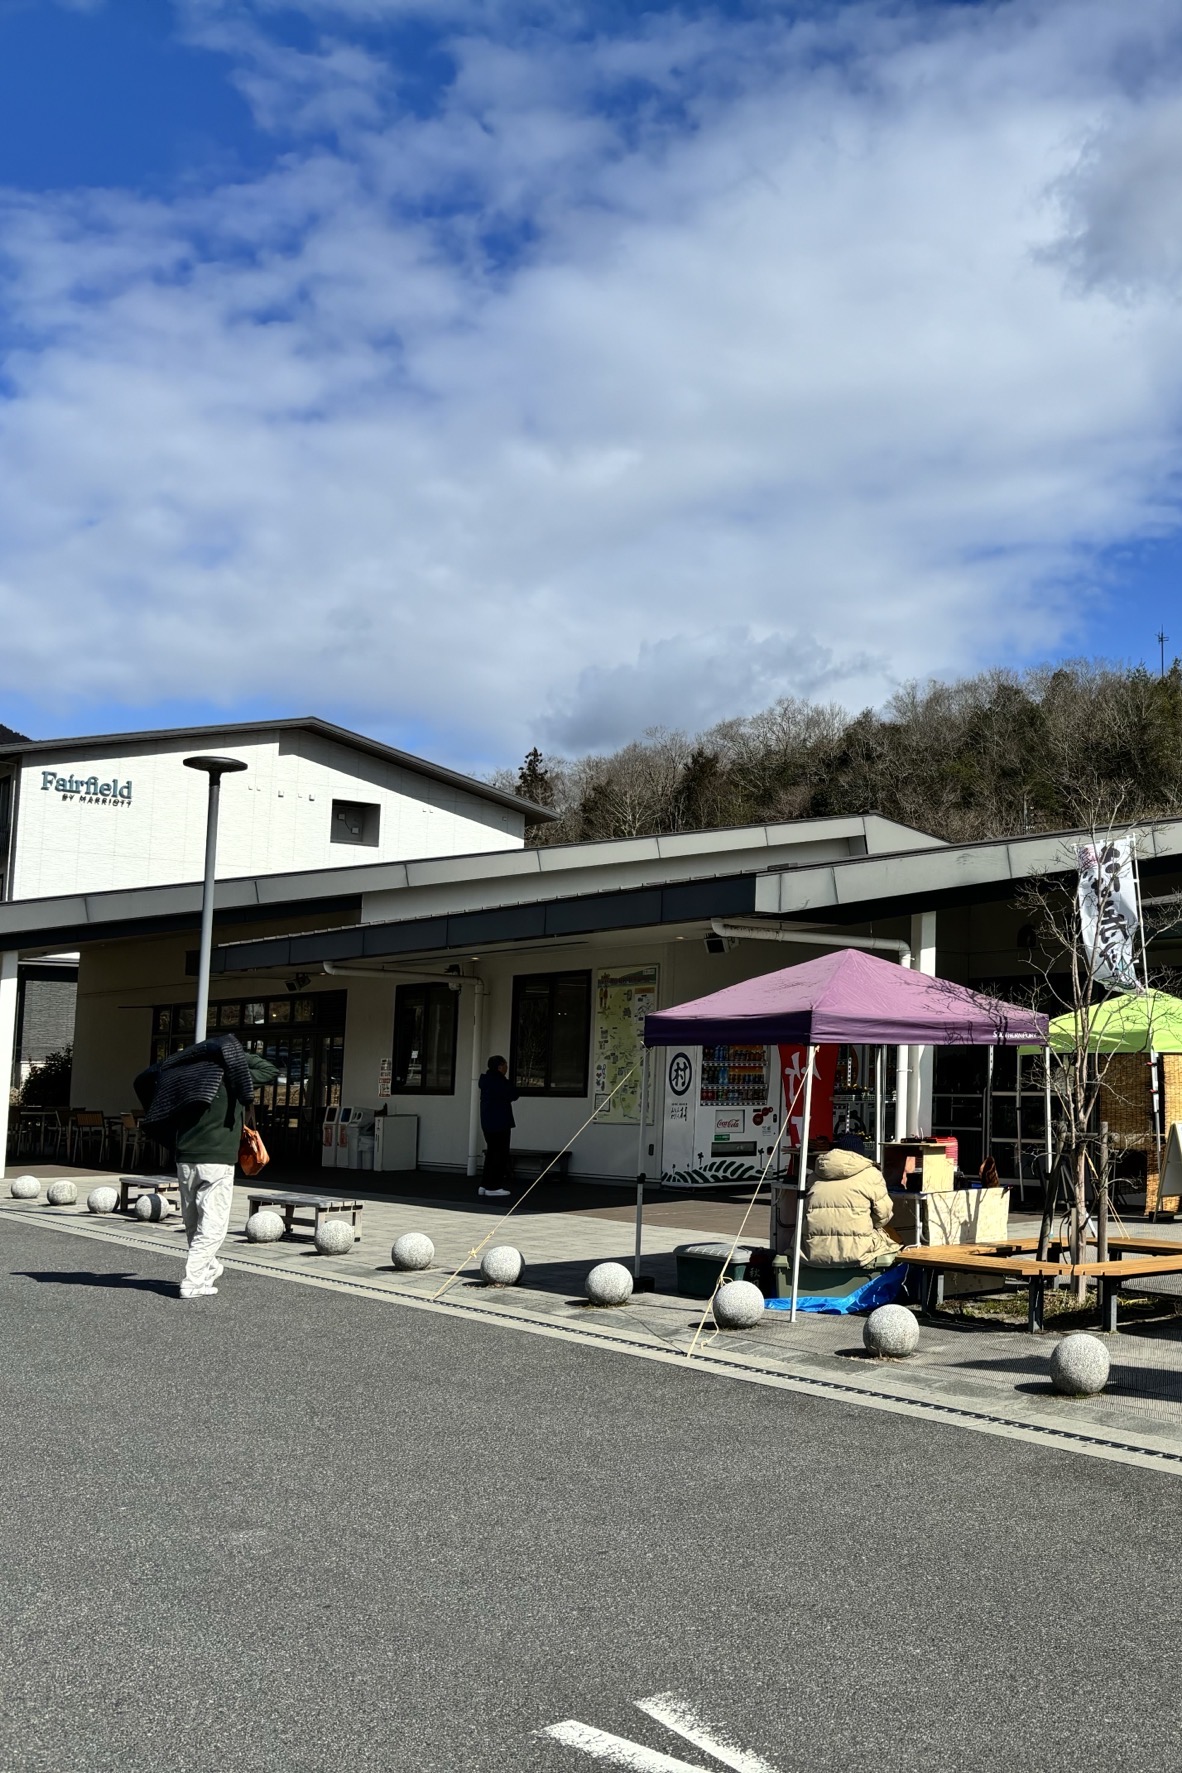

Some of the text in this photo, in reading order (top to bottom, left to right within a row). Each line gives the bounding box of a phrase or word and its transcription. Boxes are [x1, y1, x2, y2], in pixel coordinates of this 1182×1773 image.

[41, 771, 132, 799] Fairfield
[62, 793, 132, 808] BY MARRIOTT
[672, 1061, 689, 1087] 村
